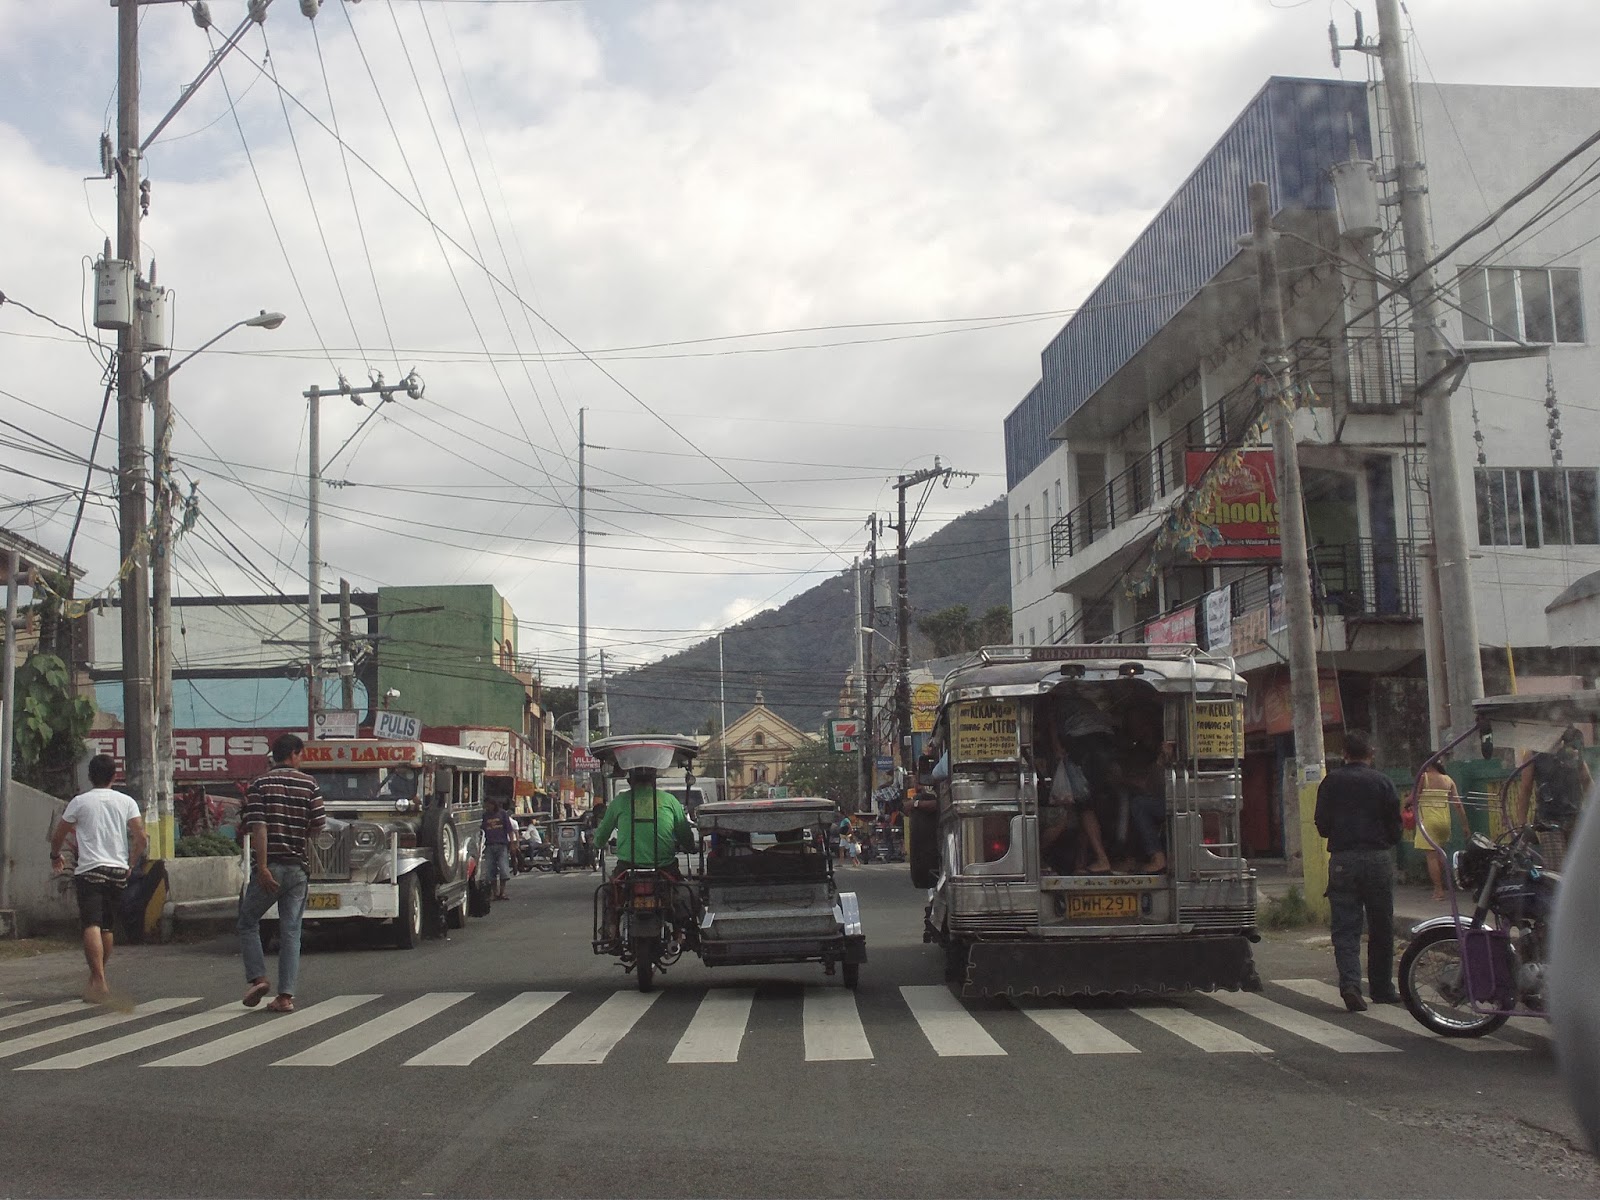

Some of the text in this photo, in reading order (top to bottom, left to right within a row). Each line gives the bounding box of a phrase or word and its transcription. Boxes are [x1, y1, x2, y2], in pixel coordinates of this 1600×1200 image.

[380, 713, 416, 736] PULIS
[301, 746, 416, 761] ARK & LANCE
[488, 741, 509, 761] Cola
